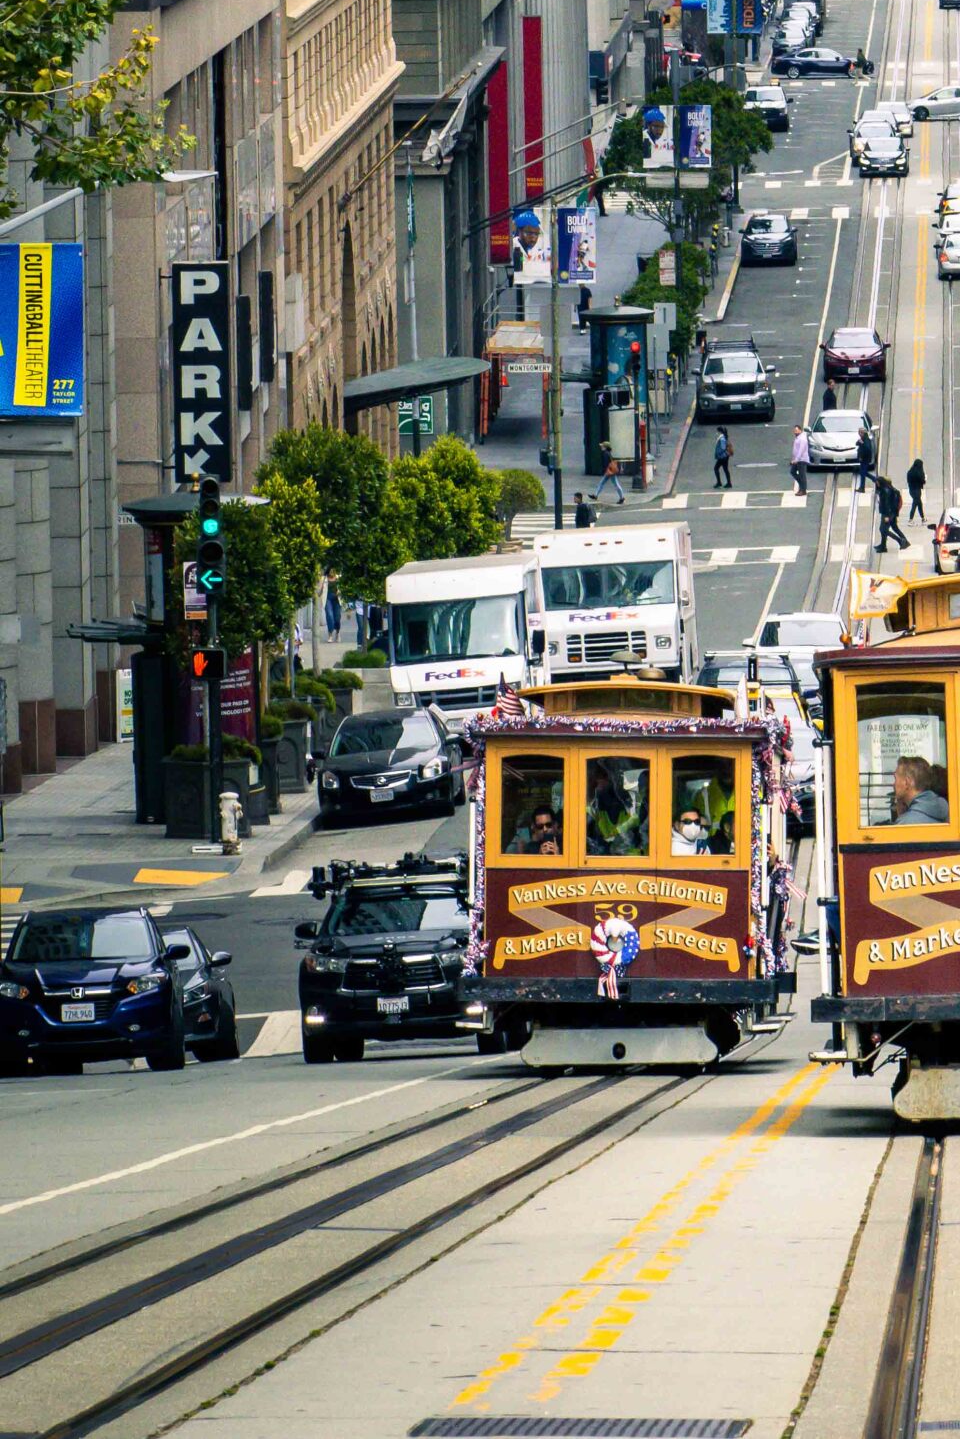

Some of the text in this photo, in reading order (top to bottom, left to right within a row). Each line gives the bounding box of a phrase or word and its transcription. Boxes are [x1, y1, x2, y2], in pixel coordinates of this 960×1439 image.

[567, 216, 587, 226] BOLD
[180, 270, 224, 445] PARK
[52, 379, 75, 390] 277
[568, 611, 640, 623] FedEx
[424, 668, 486, 682] FedEx
[874, 869, 917, 893] Van
[512, 887, 543, 905] Van
[545, 883, 587, 899] Ness
[637, 880, 724, 906] California
[594, 903, 638, 922] 59
[504, 928, 728, 955] & Market Streets
[869, 941, 885, 962] &
